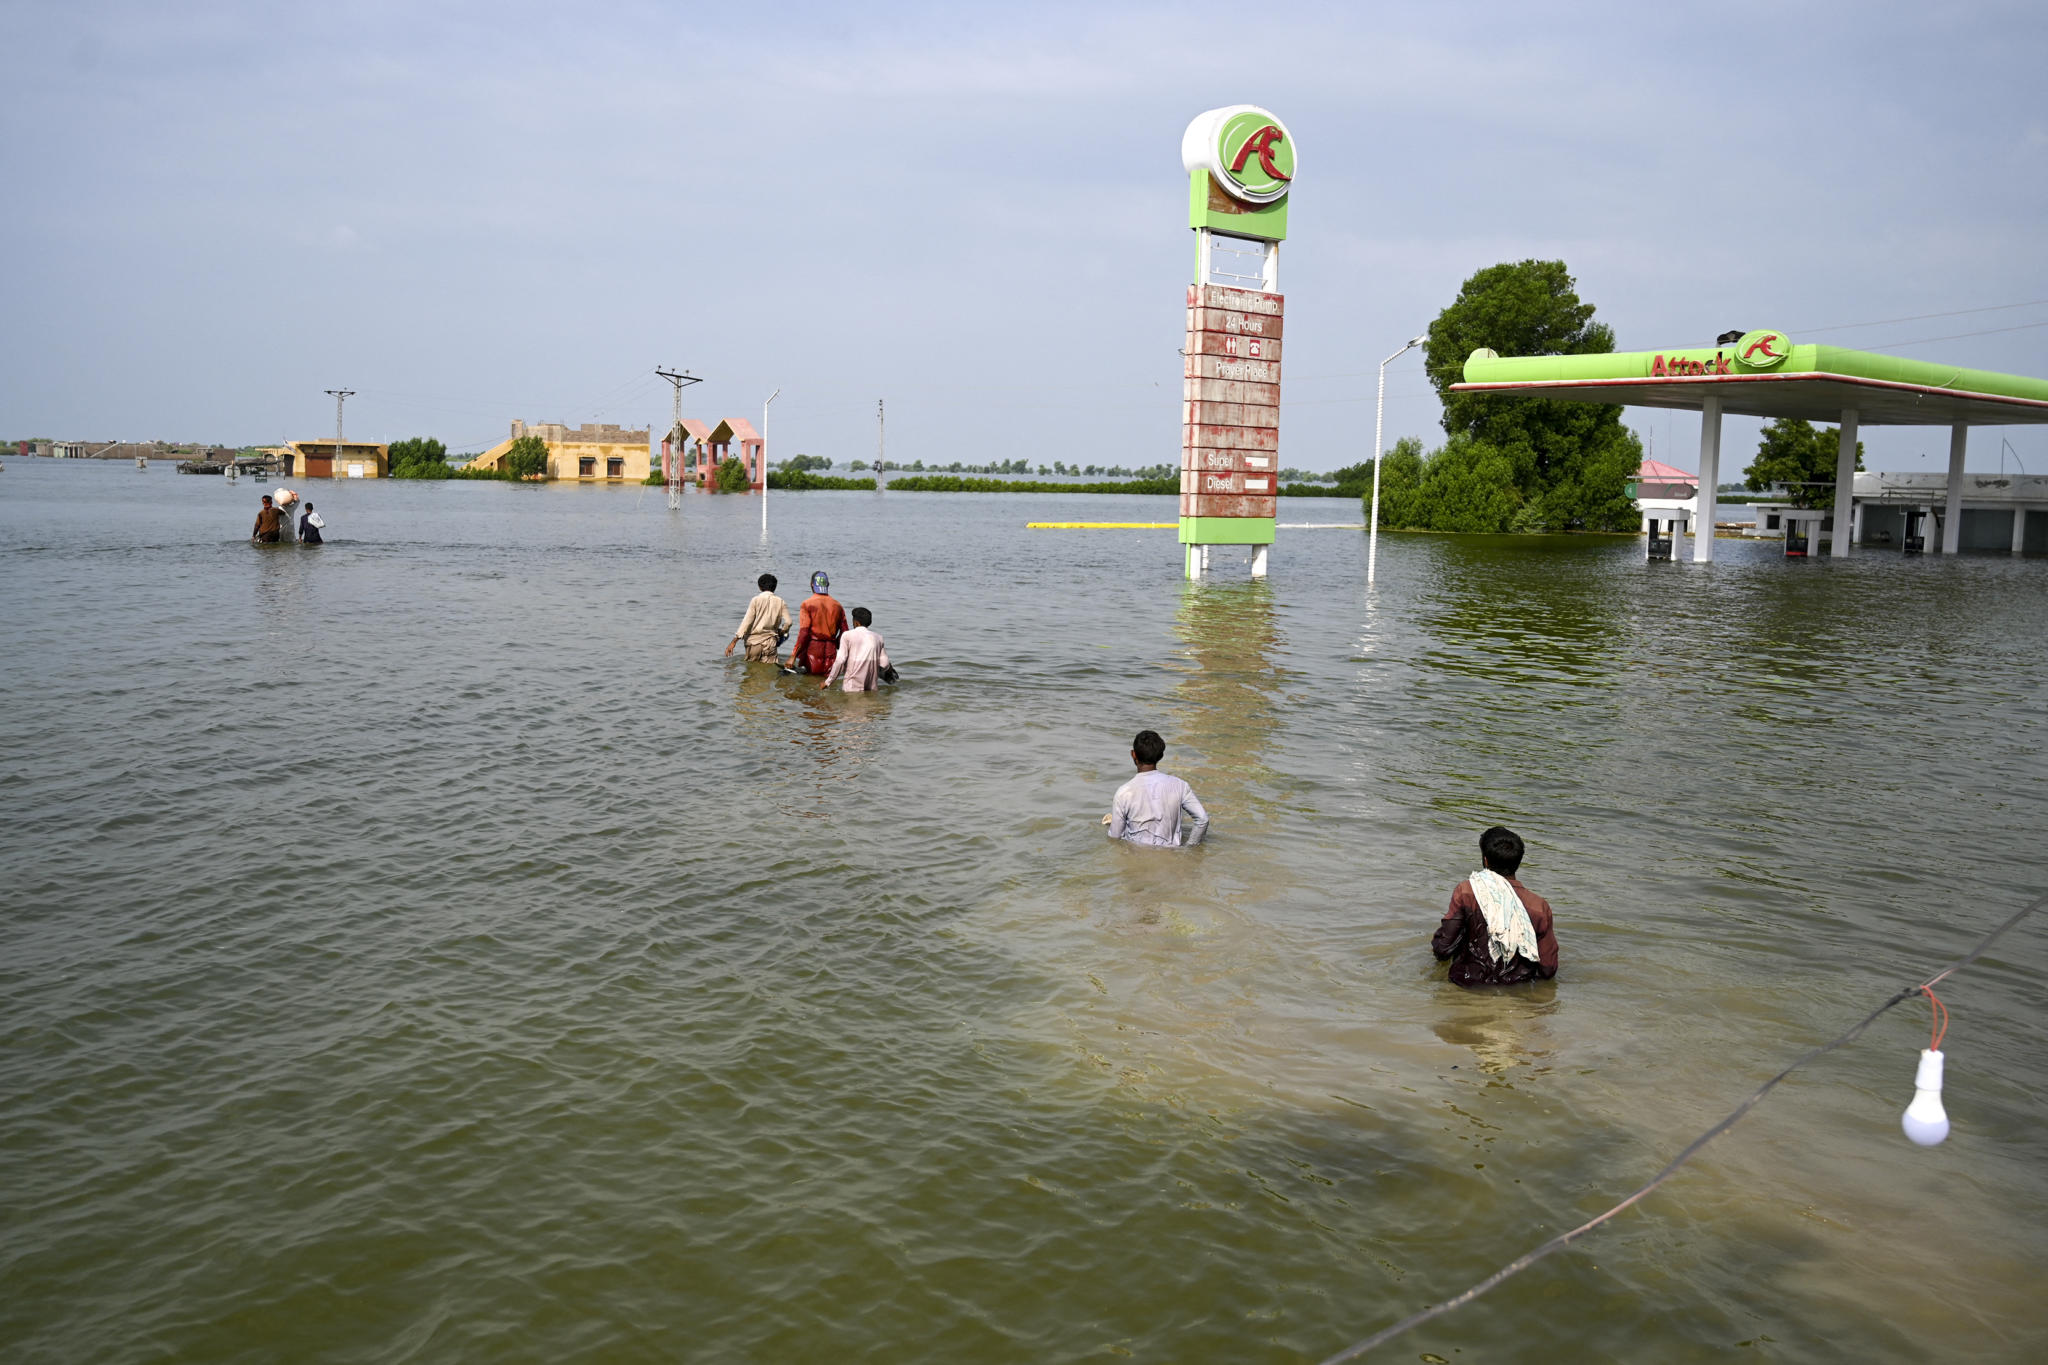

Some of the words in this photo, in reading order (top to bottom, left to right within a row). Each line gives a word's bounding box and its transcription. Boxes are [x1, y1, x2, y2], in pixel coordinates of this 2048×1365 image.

[1211, 291, 1254, 308] Electronic
[1254, 296, 1278, 312] Pump
[1226, 316, 1236, 329] 24
[1238, 318, 1263, 332] Hours
[1216, 361, 1244, 377] Prayer
[1245, 364, 1268, 377] Place
[1651, 351, 1732, 377] Attock
[1208, 453, 1234, 467] Super
[1207, 477, 1233, 489] Diesel
